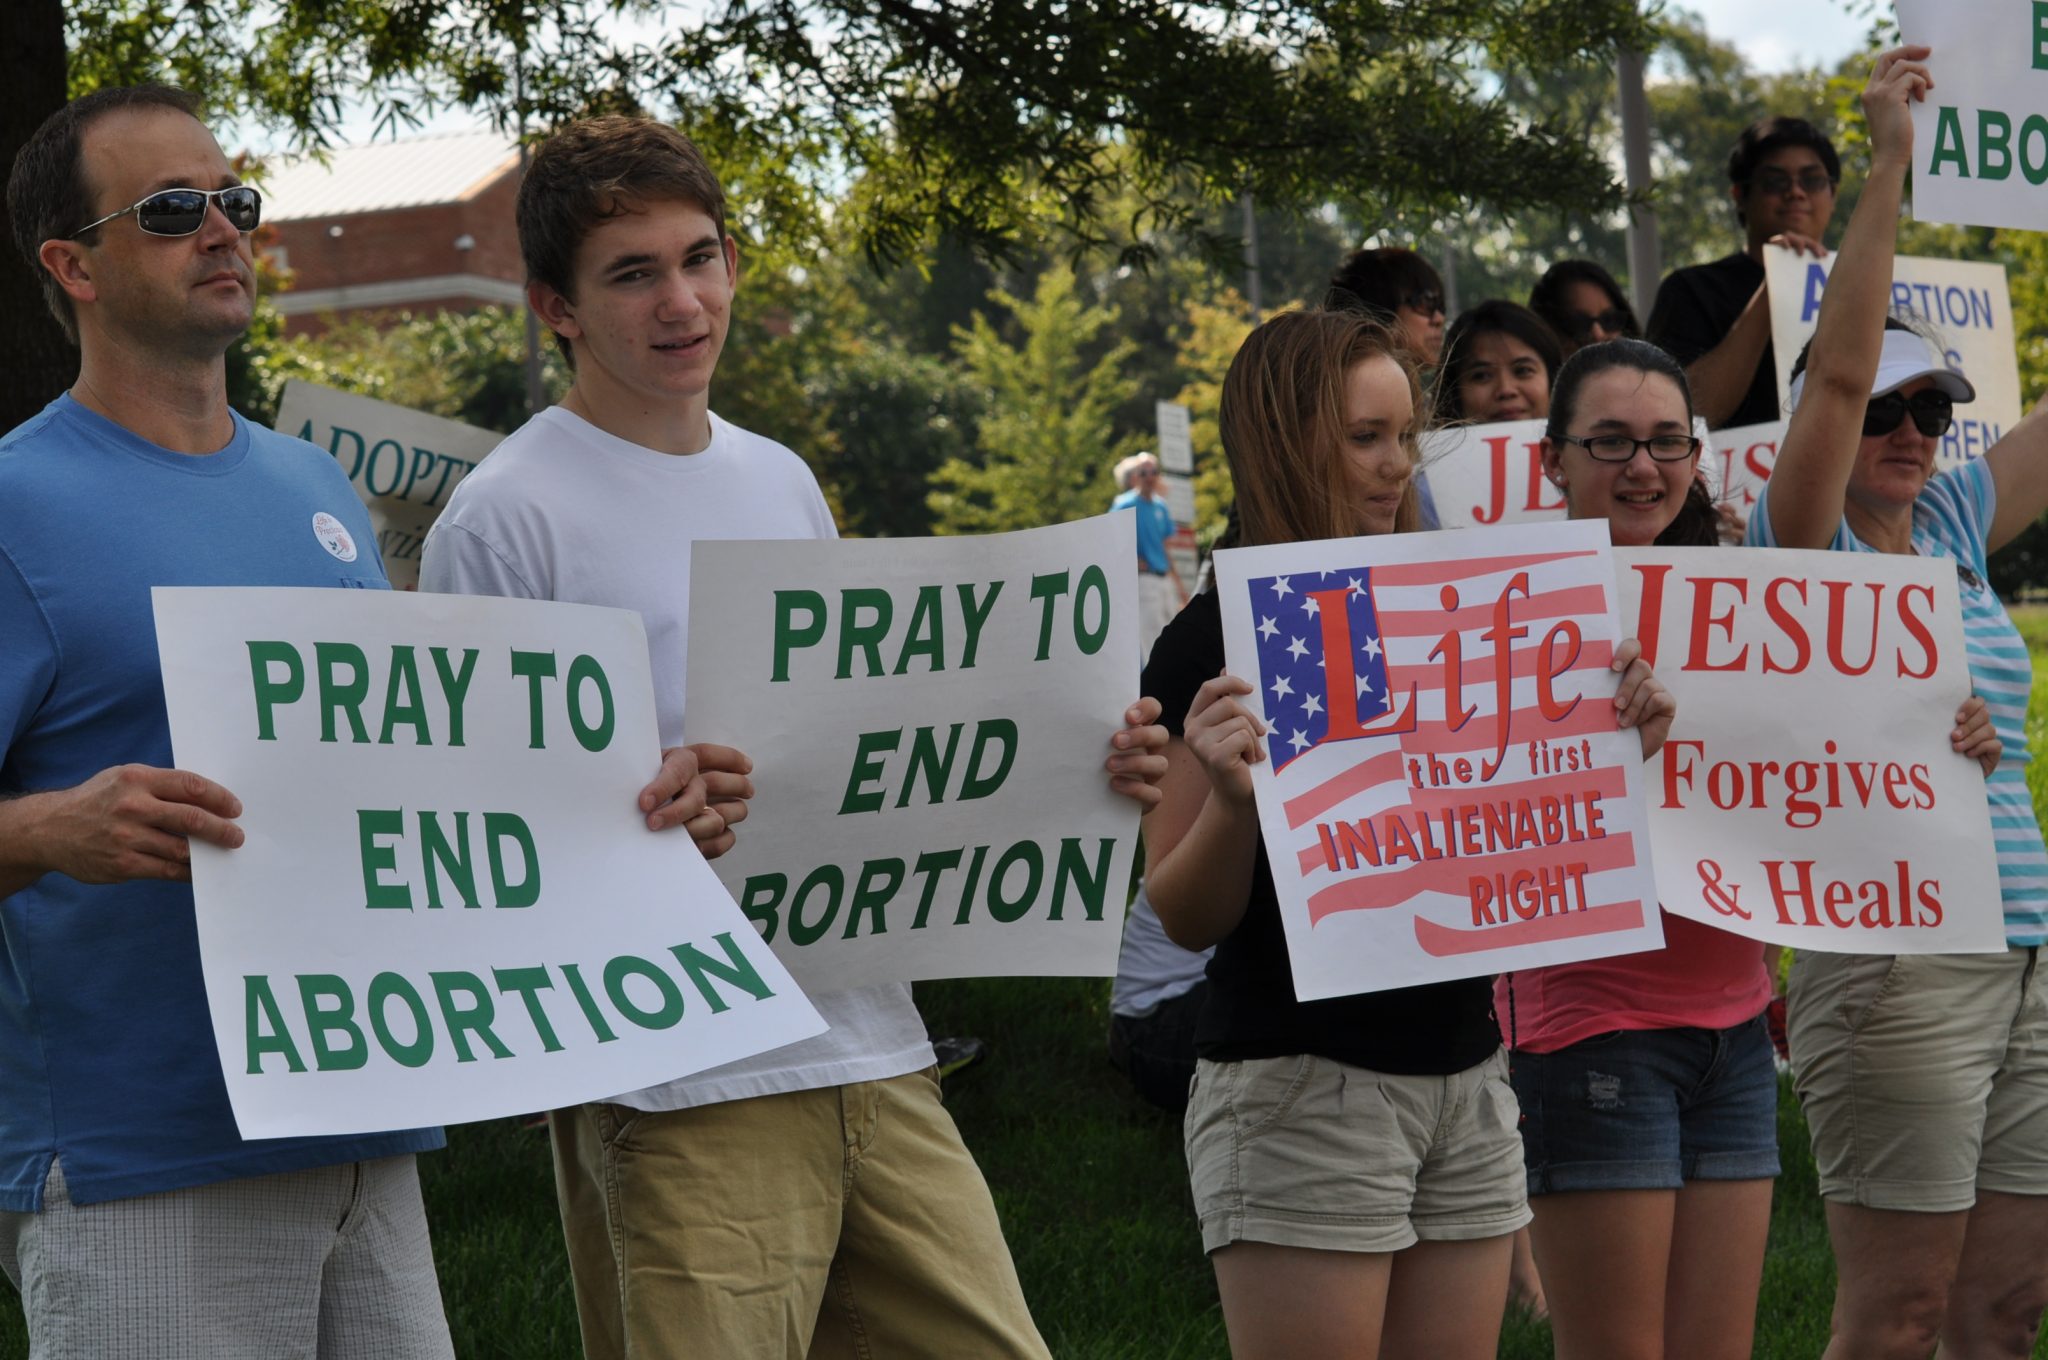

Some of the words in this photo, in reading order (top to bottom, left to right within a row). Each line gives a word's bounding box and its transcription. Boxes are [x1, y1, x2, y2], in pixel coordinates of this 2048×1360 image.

[1801, 263, 1994, 330] ARTION
[770, 580, 1005, 683] PRAY
[1029, 564, 1111, 662] TO
[1631, 564, 1939, 680] JESUS
[244, 640, 480, 747] PRAY
[510, 646, 616, 753] TO
[1305, 572, 1583, 782] Life
[837, 718, 1019, 815] END
[1408, 752, 1473, 790] the
[1528, 739, 1593, 776] first
[1660, 740, 1936, 829] Forgives
[356, 806, 541, 914] END
[1316, 790, 1607, 873] INALIENABLE
[720, 837, 1118, 947] BORTION
[1469, 862, 1590, 927] RIGHT
[1696, 858, 1752, 921] &
[1760, 860, 1944, 929] Heals
[242, 932, 778, 1075] ABORTION
